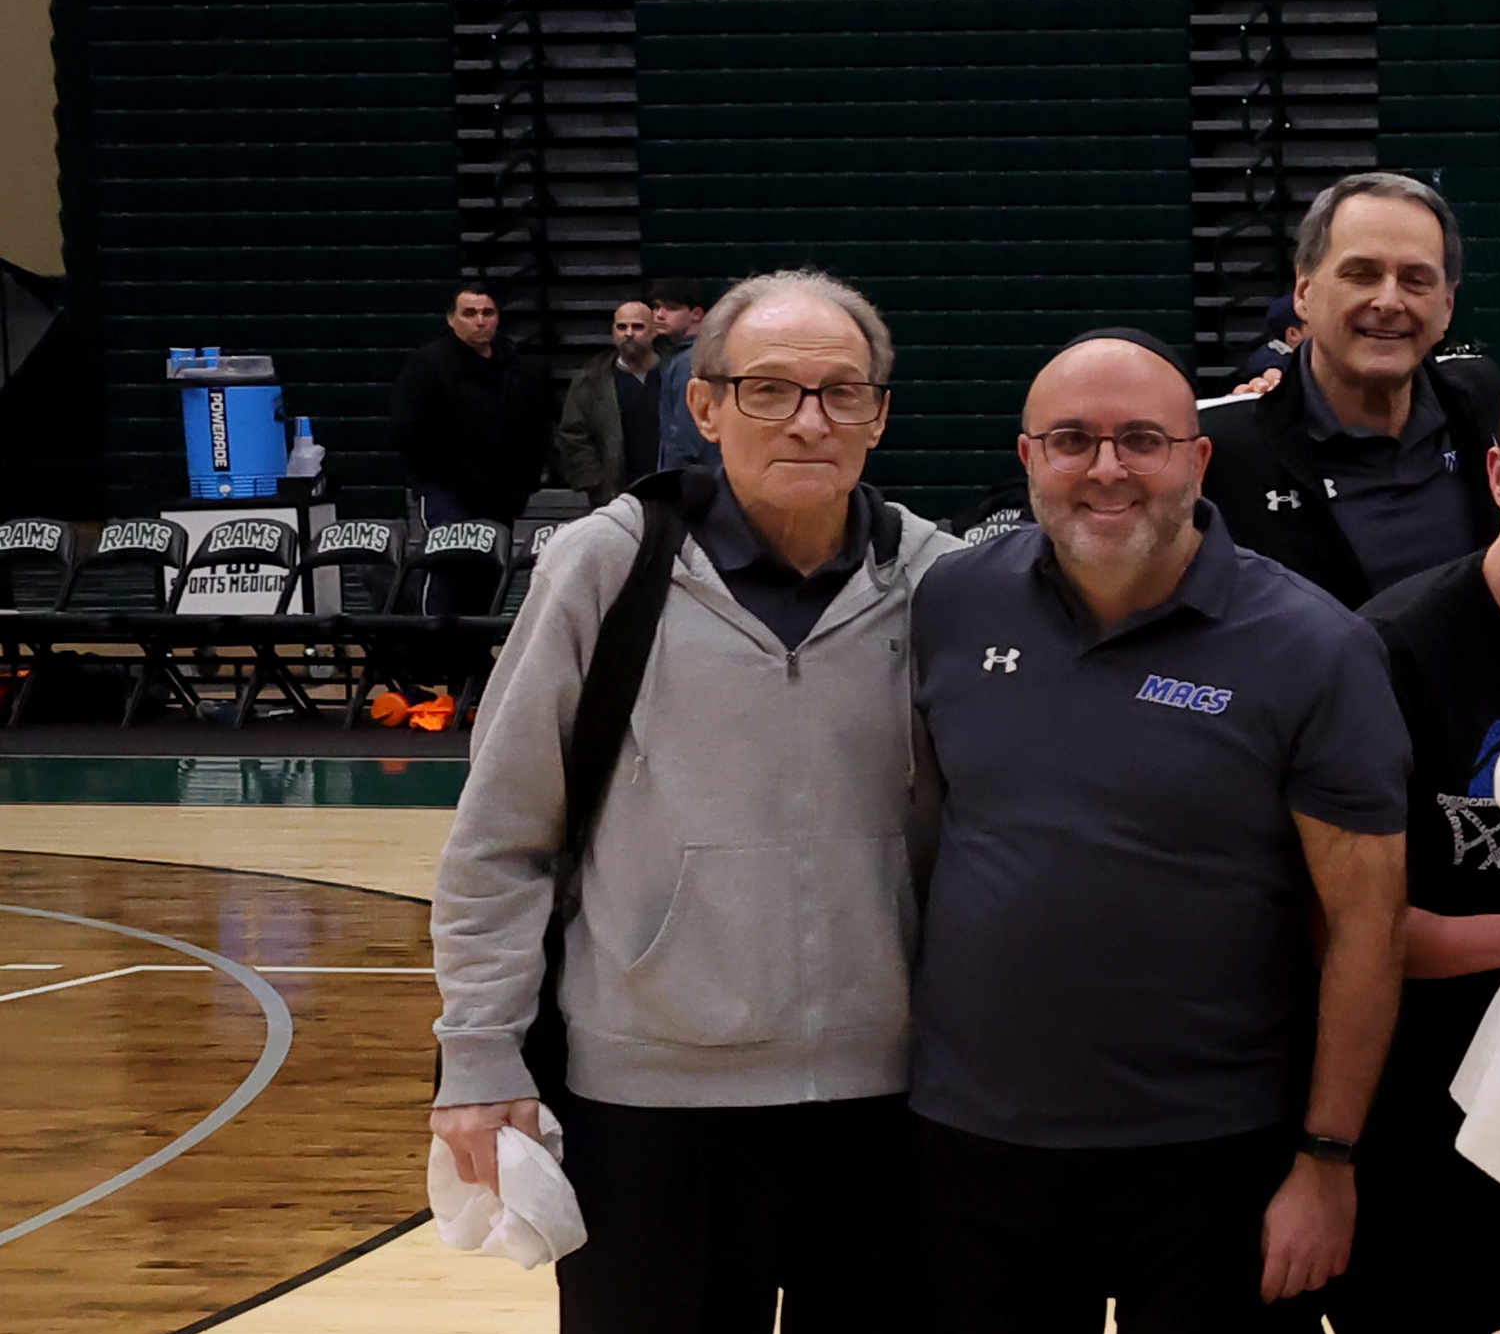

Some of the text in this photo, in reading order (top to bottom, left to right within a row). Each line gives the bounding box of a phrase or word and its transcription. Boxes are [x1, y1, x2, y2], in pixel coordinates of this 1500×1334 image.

[209, 392, 228, 468] POWERADE
[98, 522, 173, 554] RAMS
[208, 522, 283, 553] RAMS
[318, 522, 391, 554] RAMS
[425, 522, 497, 555] RAMS
[1135, 674, 1233, 716] MACS
